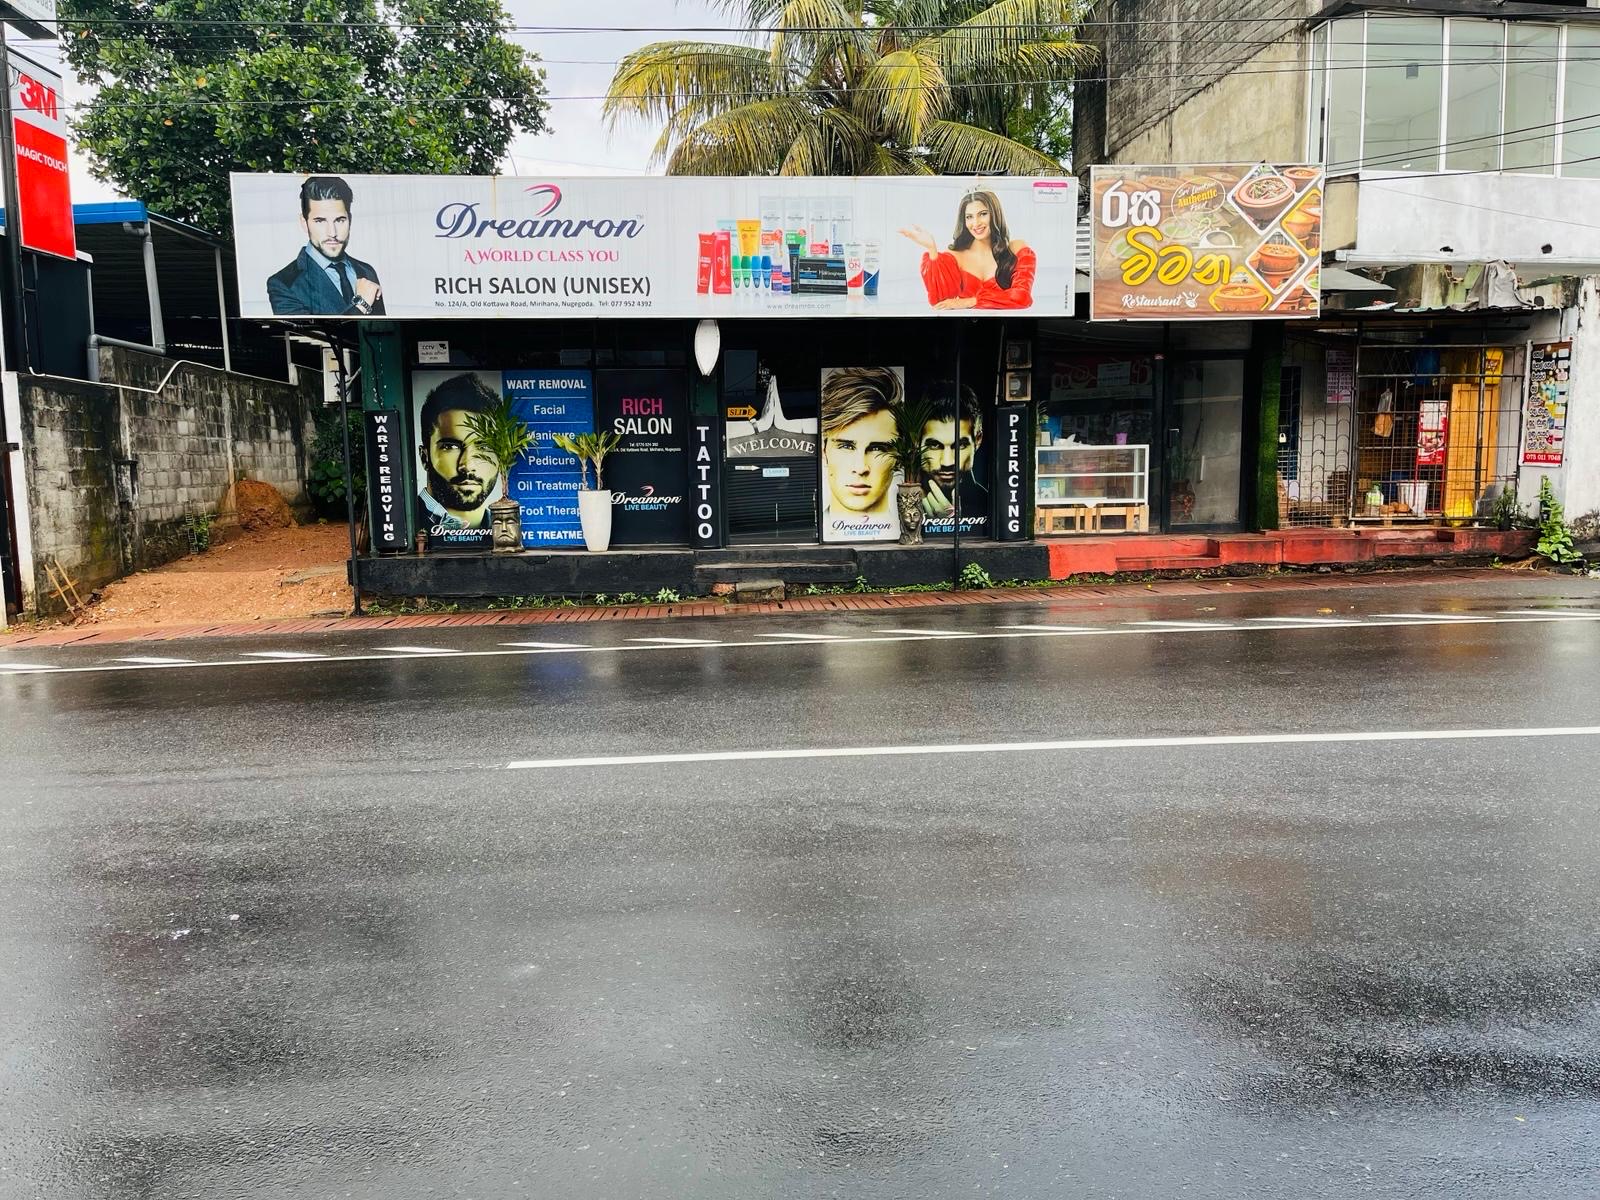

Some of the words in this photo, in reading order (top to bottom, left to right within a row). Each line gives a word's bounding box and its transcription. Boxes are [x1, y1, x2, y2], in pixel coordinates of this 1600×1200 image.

[19, 74, 58, 121] 3M
[17, 144, 43, 164] MAGIC
[43, 154, 67, 173] TOUCH
[435, 202, 645, 239] Dreamron
[464, 249, 478, 265] A
[477, 247, 534, 264] WORLD
[537, 250, 584, 262] CLASS
[588, 250, 620, 262] YOU
[434, 277, 482, 294] RICH
[488, 277, 556, 294] SALON
[563, 276, 651, 296] (UNISEX)
[1122, 293, 1182, 309] Restaurant
[506, 379, 535, 390] WART
[539, 379, 587, 389] REMOVAL
[533, 404, 566, 415] Facial
[622, 398, 663, 415] RICH
[729, 408, 753, 416] SLIDE
[613, 417, 673, 435] SALON
[374, 415, 390, 462] WARTS
[732, 437, 816, 455] WELCOME
[528, 455, 576, 465] Pedicure
[1008, 414, 1020, 532] PIERCING
[517, 481, 533, 491] Oil
[696, 426, 713, 539] TATTOO
[379, 466, 395, 541] REMOVING
[611, 491, 682, 505] Dreamron
[519, 506, 544, 515] Foot
[546, 505, 581, 517] Therap
[832, 519, 892, 530] Dreamron
[521, 531, 534, 540] YE
